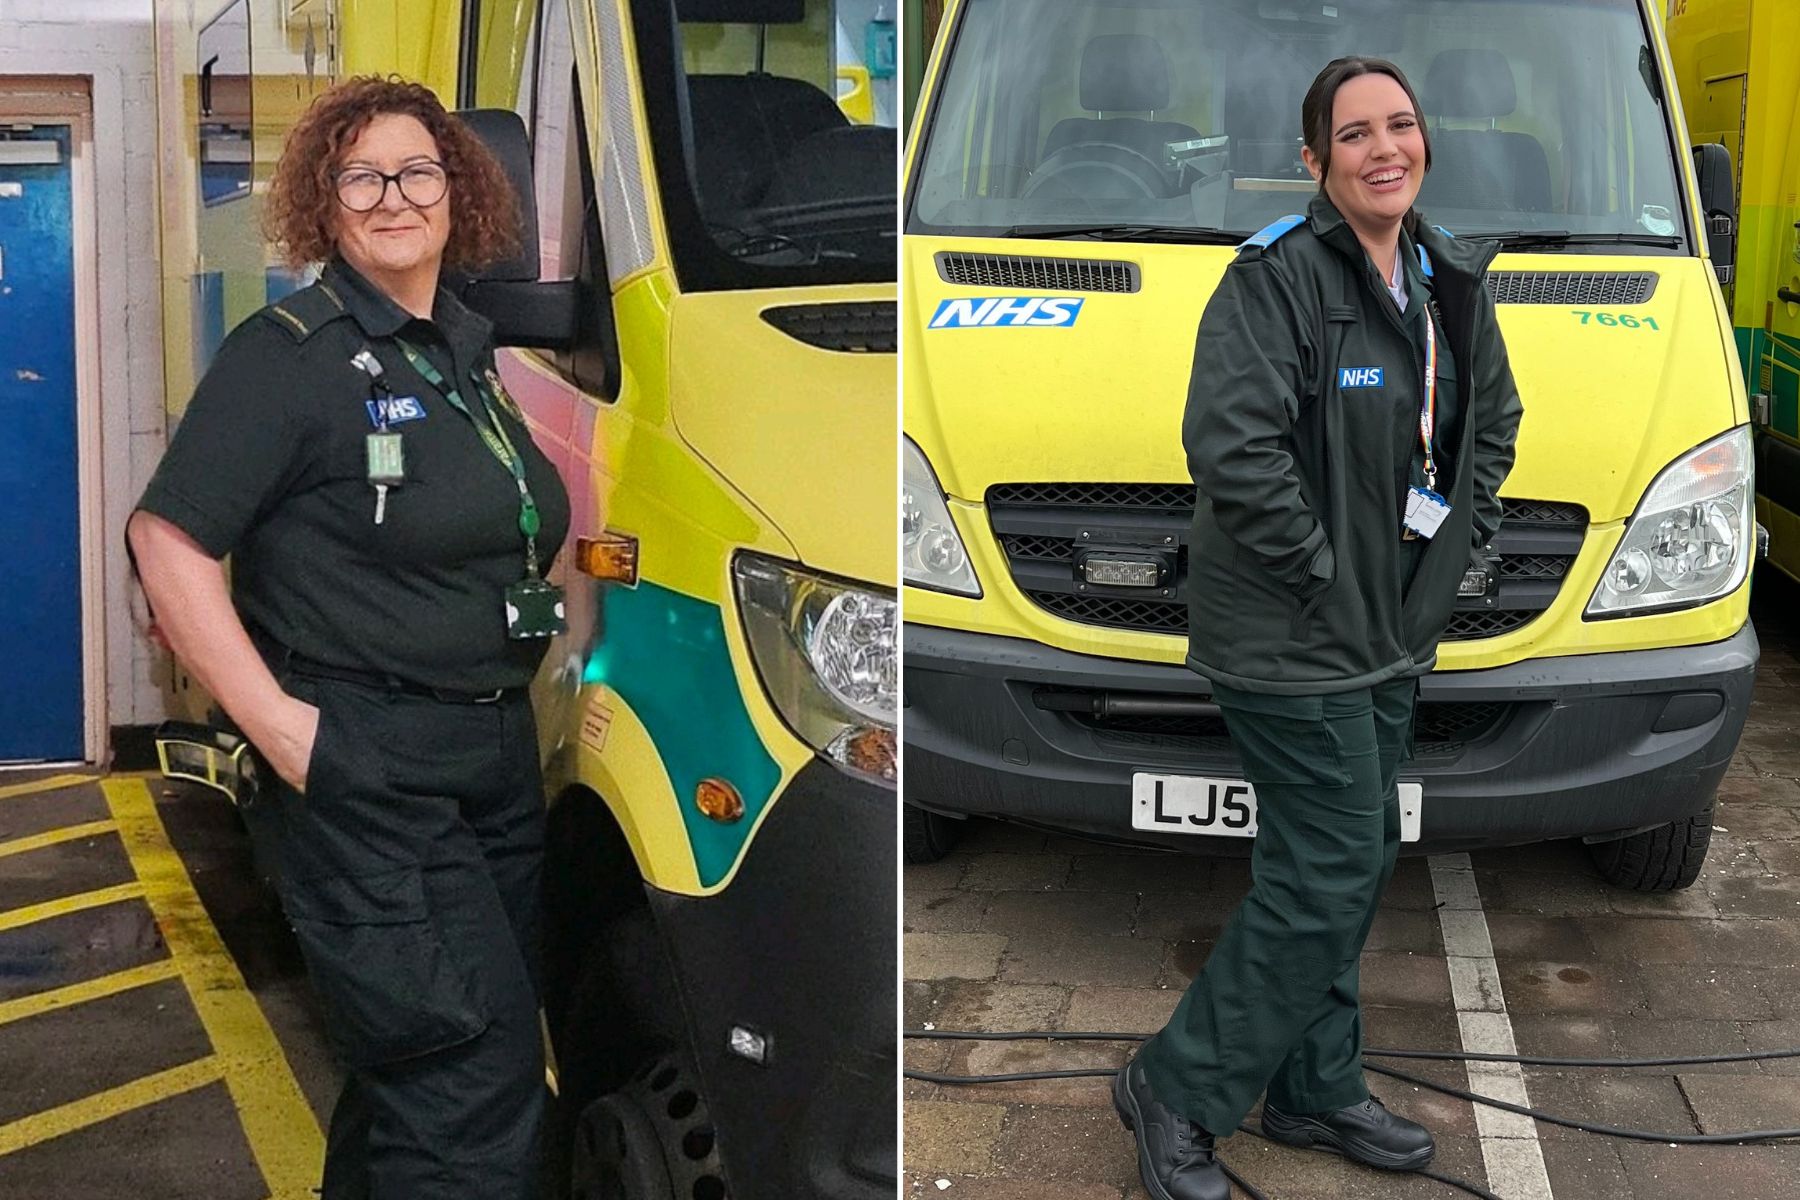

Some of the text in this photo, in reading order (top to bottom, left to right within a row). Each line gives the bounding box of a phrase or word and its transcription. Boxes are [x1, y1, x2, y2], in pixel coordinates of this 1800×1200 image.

[931, 297, 1081, 328] NHS
[1571, 311, 1660, 330] 7661
[1342, 368, 1380, 386] NHS
[1425, 365, 1435, 387] NHS
[1154, 780, 1250, 829] LJ5
